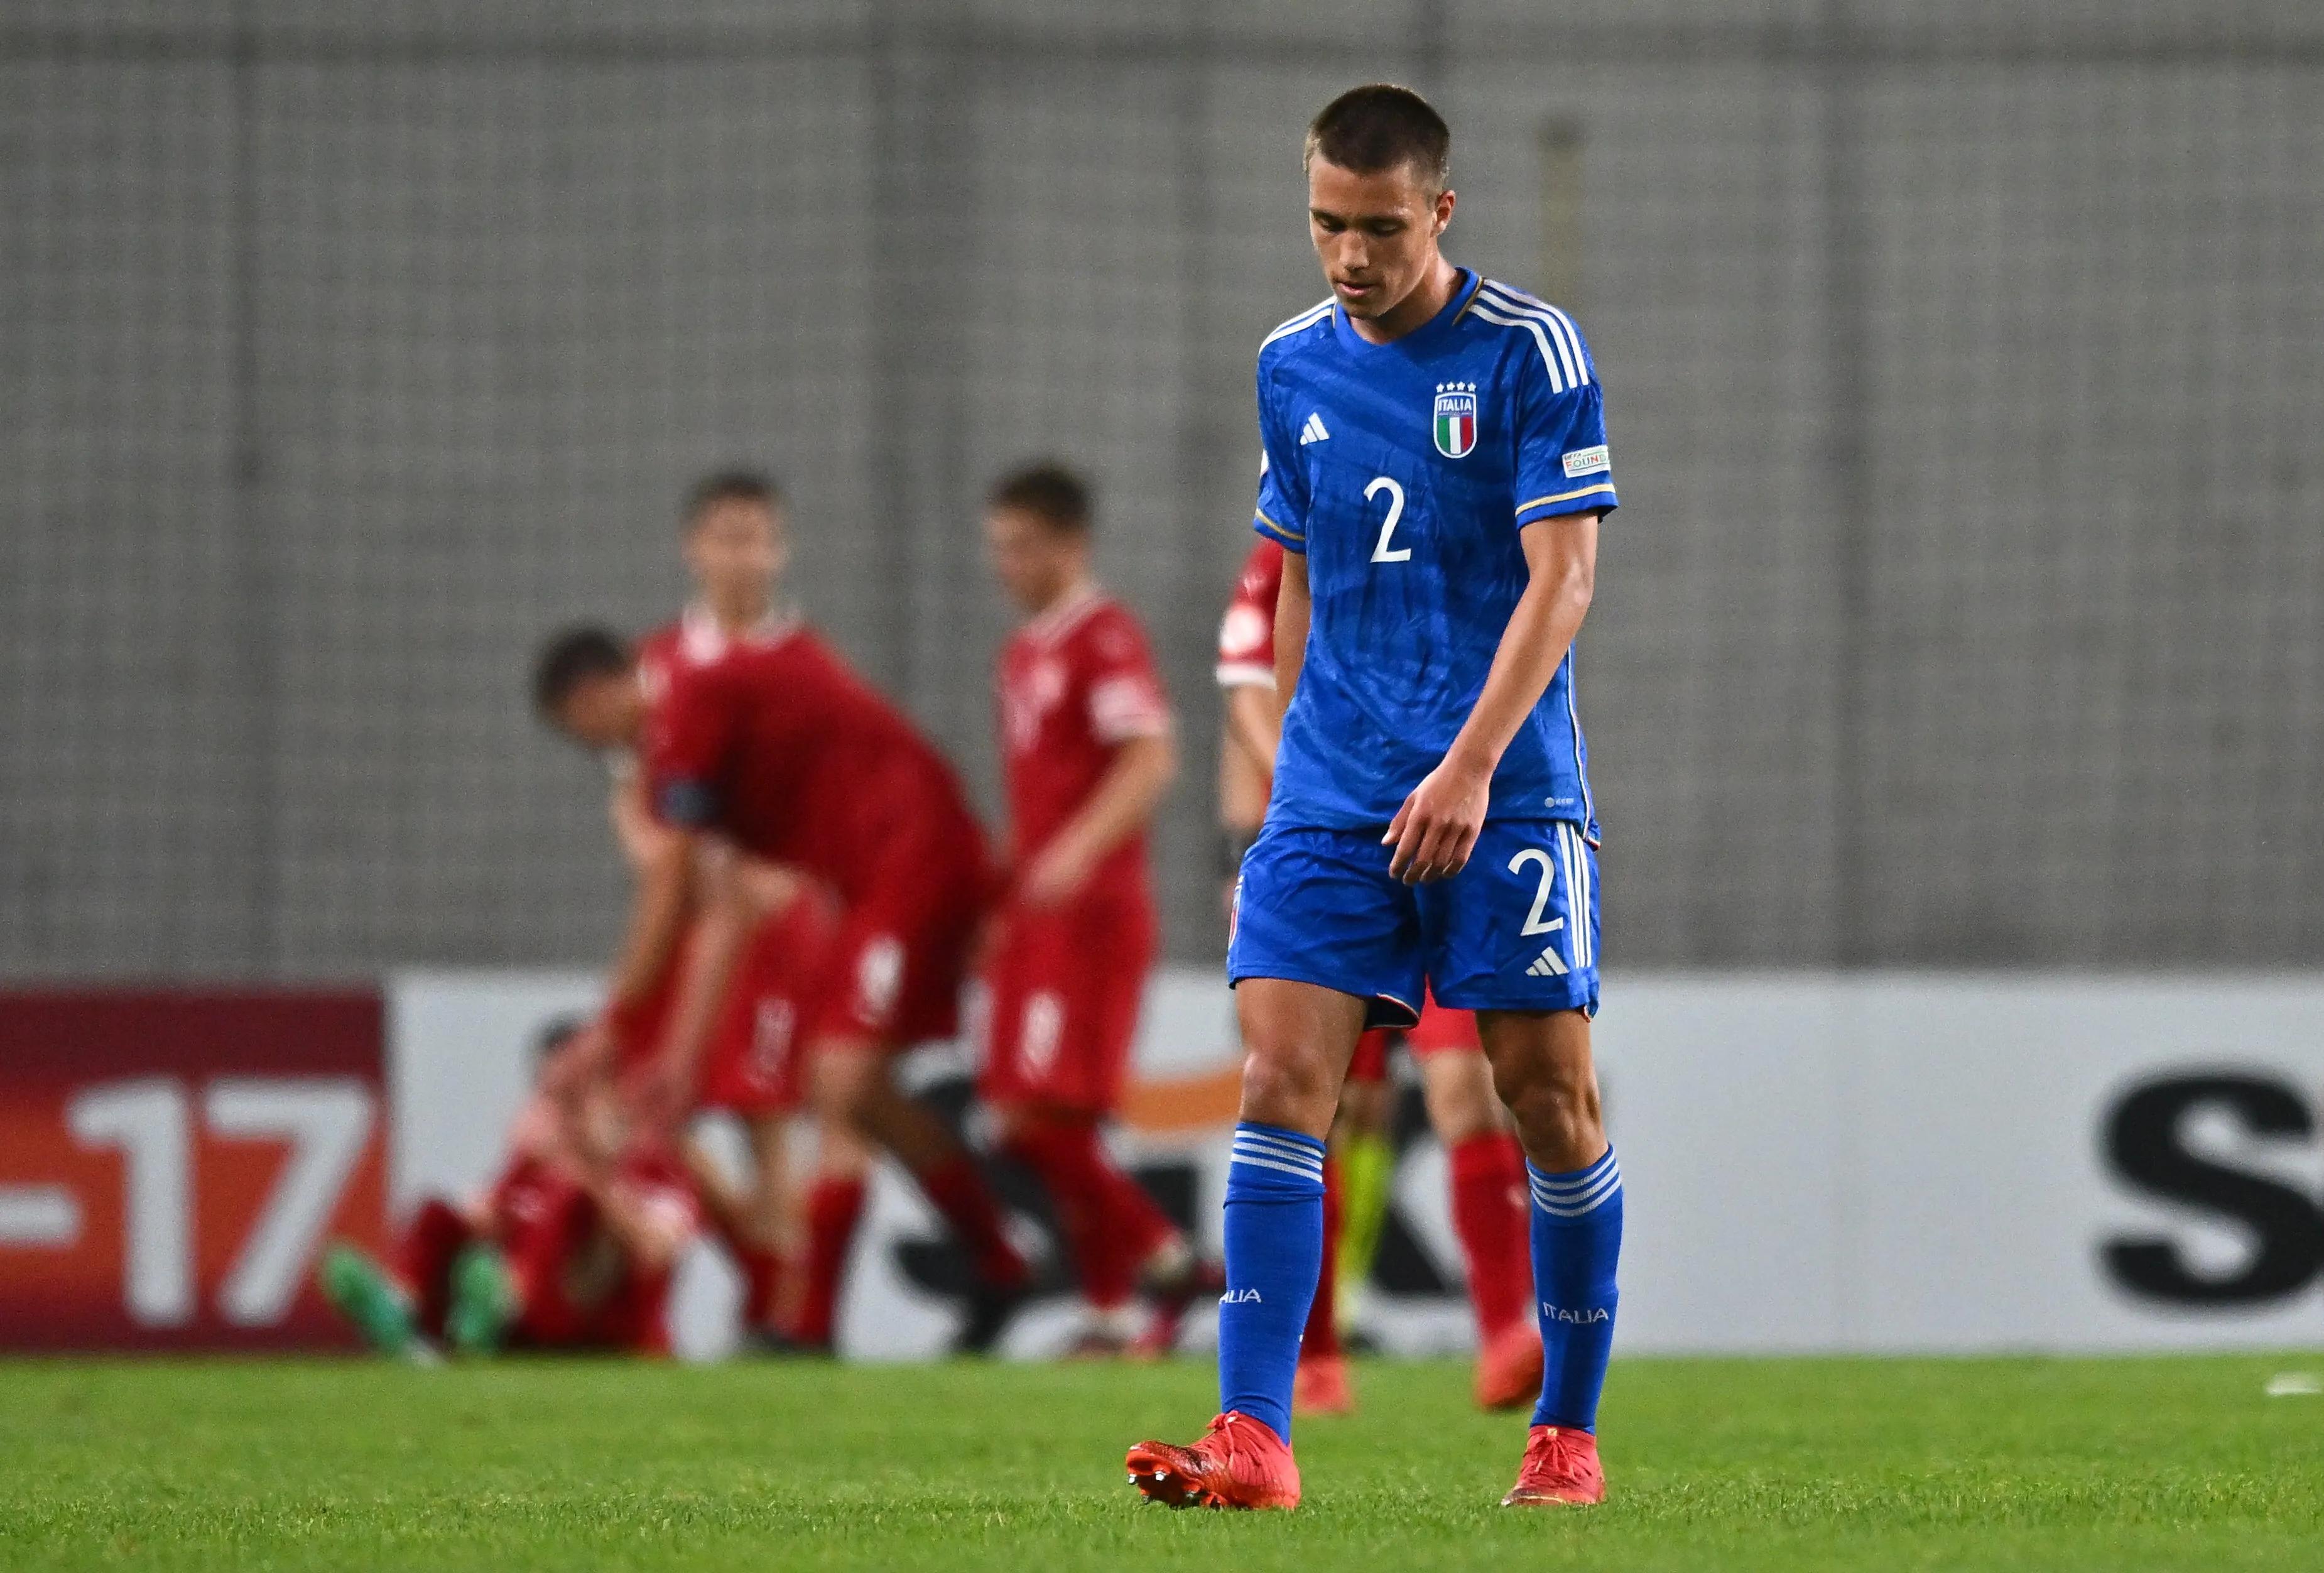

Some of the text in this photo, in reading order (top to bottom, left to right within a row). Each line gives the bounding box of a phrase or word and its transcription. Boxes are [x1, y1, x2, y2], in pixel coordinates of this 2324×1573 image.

[1438, 398, 1472, 411] ITALIA
[1363, 476, 1411, 563] 2
[1507, 848, 1563, 936] 2
[1543, 1302, 1609, 1324] ITALIA
